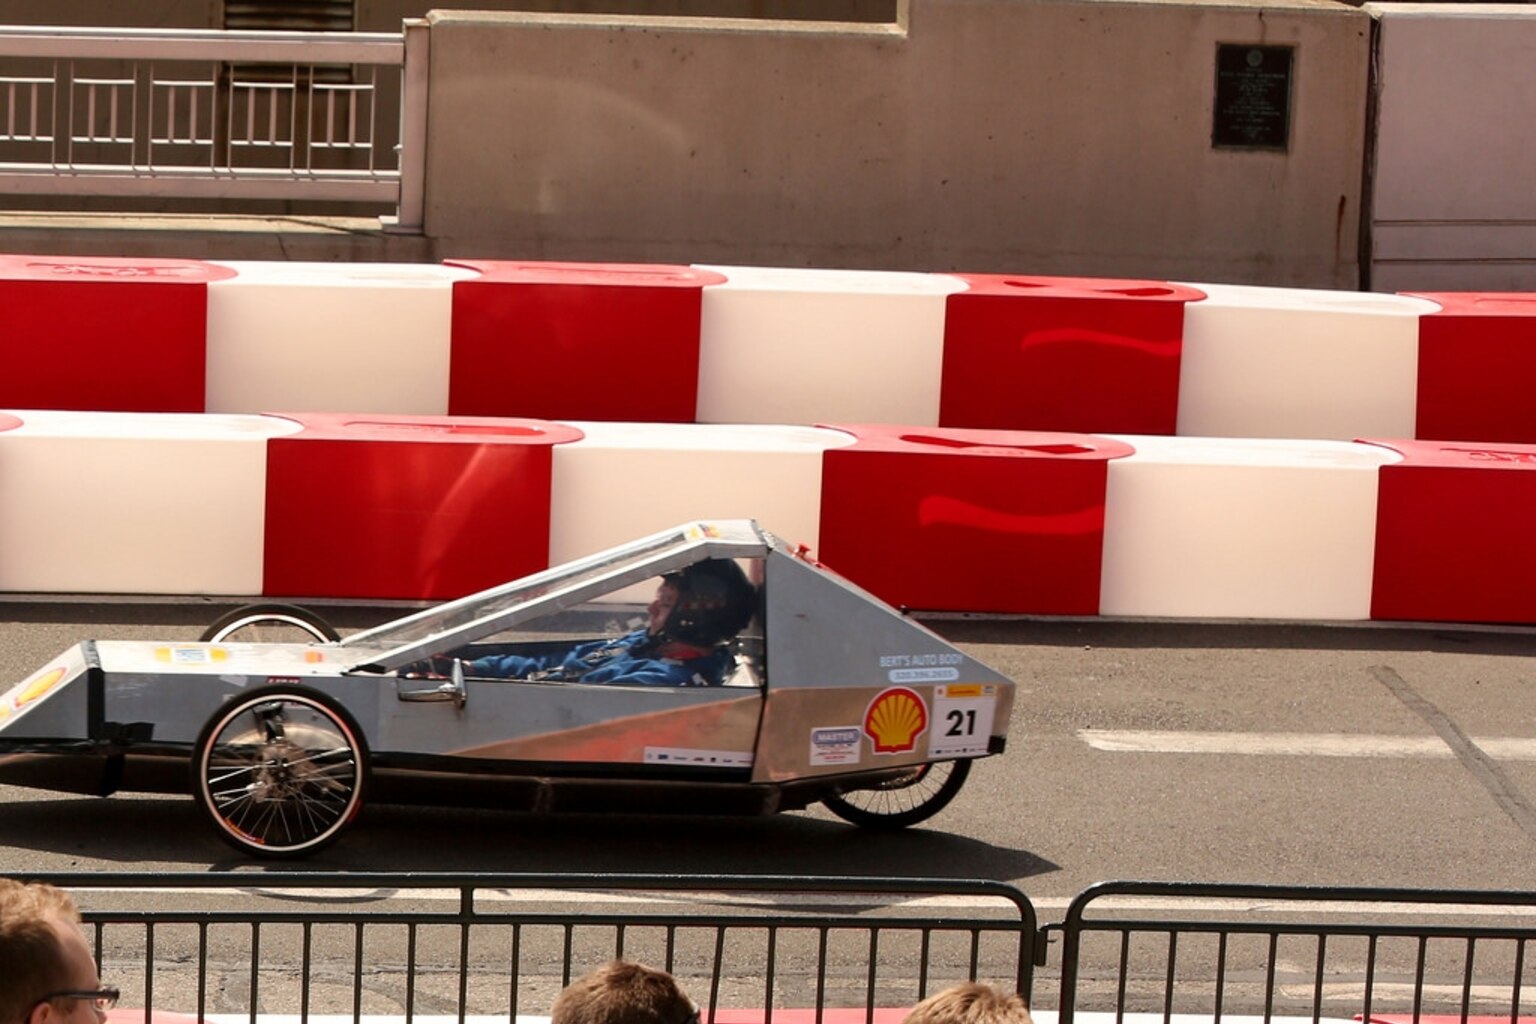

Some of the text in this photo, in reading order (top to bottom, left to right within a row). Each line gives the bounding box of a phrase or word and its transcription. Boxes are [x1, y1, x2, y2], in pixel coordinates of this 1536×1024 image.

[879, 653, 963, 668] BERT'S AUTO BODY
[945, 709, 976, 737] 21
[817, 732, 855, 741] MASTER
